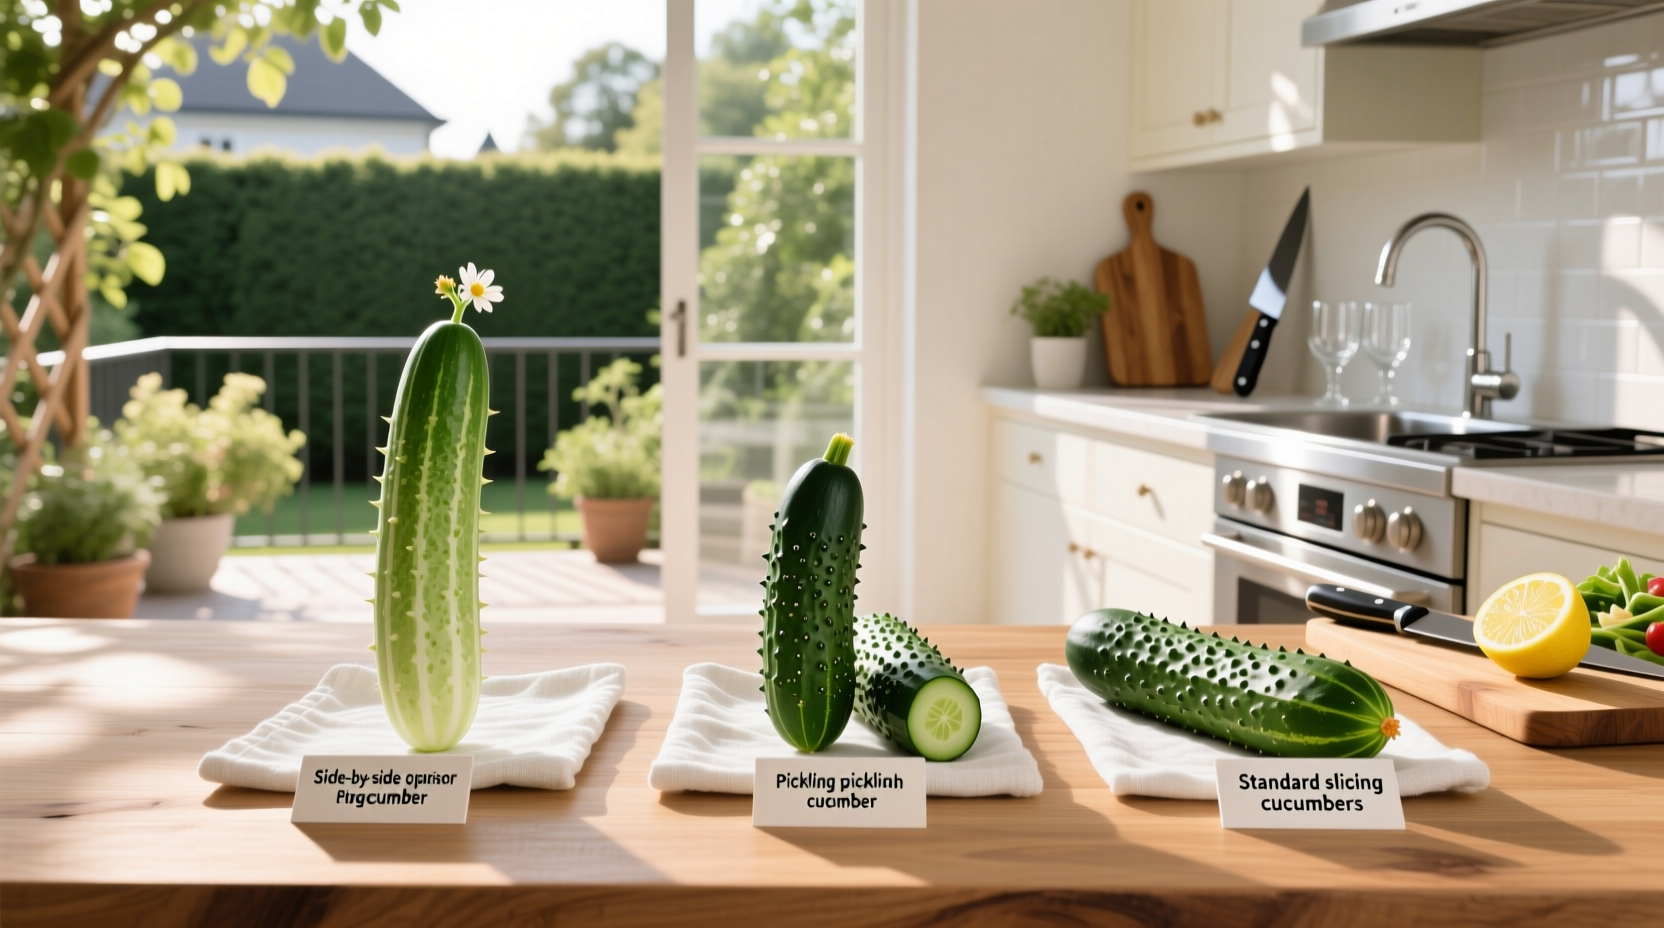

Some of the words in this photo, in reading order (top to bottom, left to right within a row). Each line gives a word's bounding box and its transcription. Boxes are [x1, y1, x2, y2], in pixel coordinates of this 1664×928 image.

[776, 772, 836, 794] Pickling
[1238, 772, 1320, 791] Standard
[1325, 772, 1384, 795] slicing
[1260, 793, 1364, 812] cucumbers
